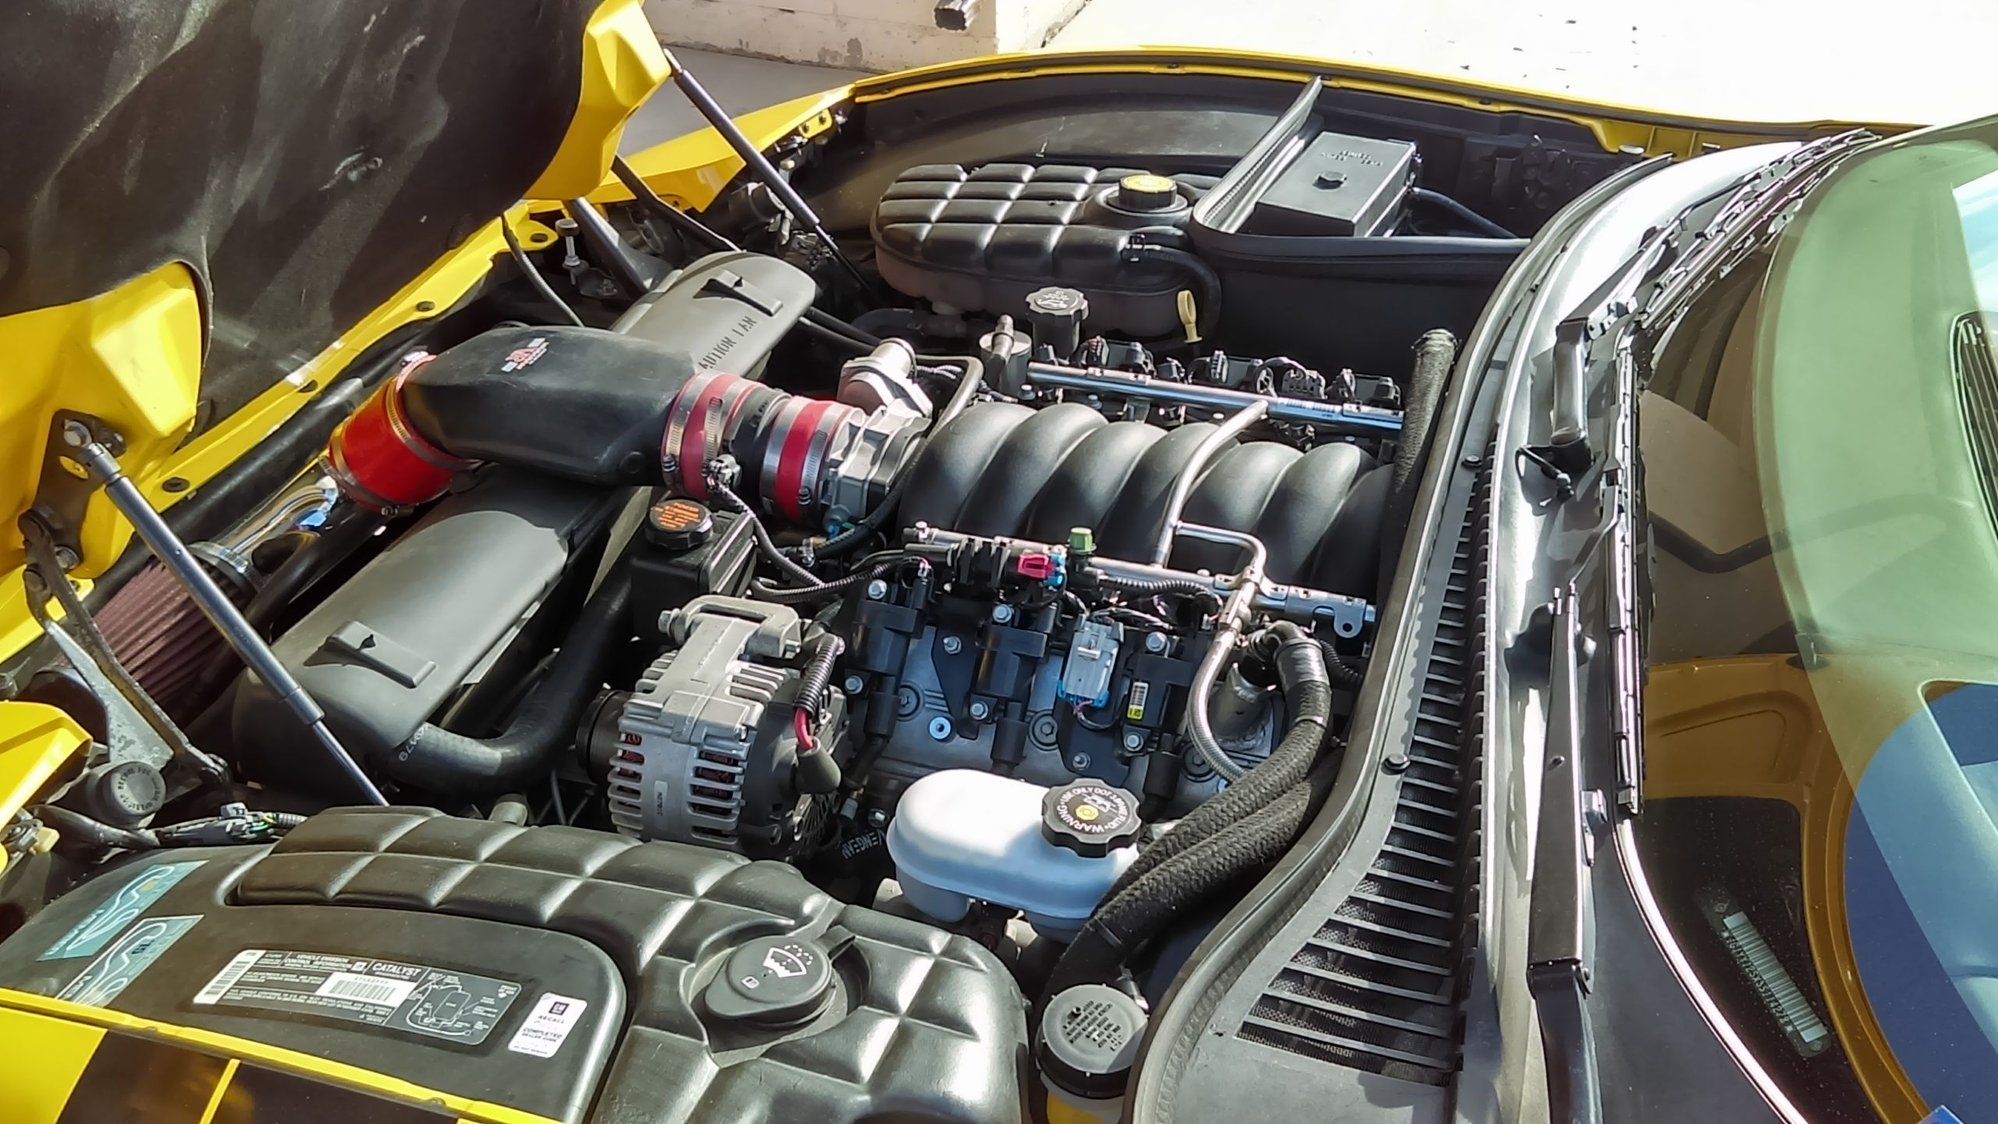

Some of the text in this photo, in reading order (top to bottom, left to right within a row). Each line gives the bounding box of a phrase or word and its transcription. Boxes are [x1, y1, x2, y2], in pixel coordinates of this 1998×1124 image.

[1072, 787, 1093, 795] ONLY
[1094, 787, 1112, 797] DOT
[1057, 803, 1105, 833] WARNING
[372, 962, 422, 977] CATALYST
[538, 1015, 565, 1024] RECALL
[522, 1027, 563, 1039] COMPLETED
